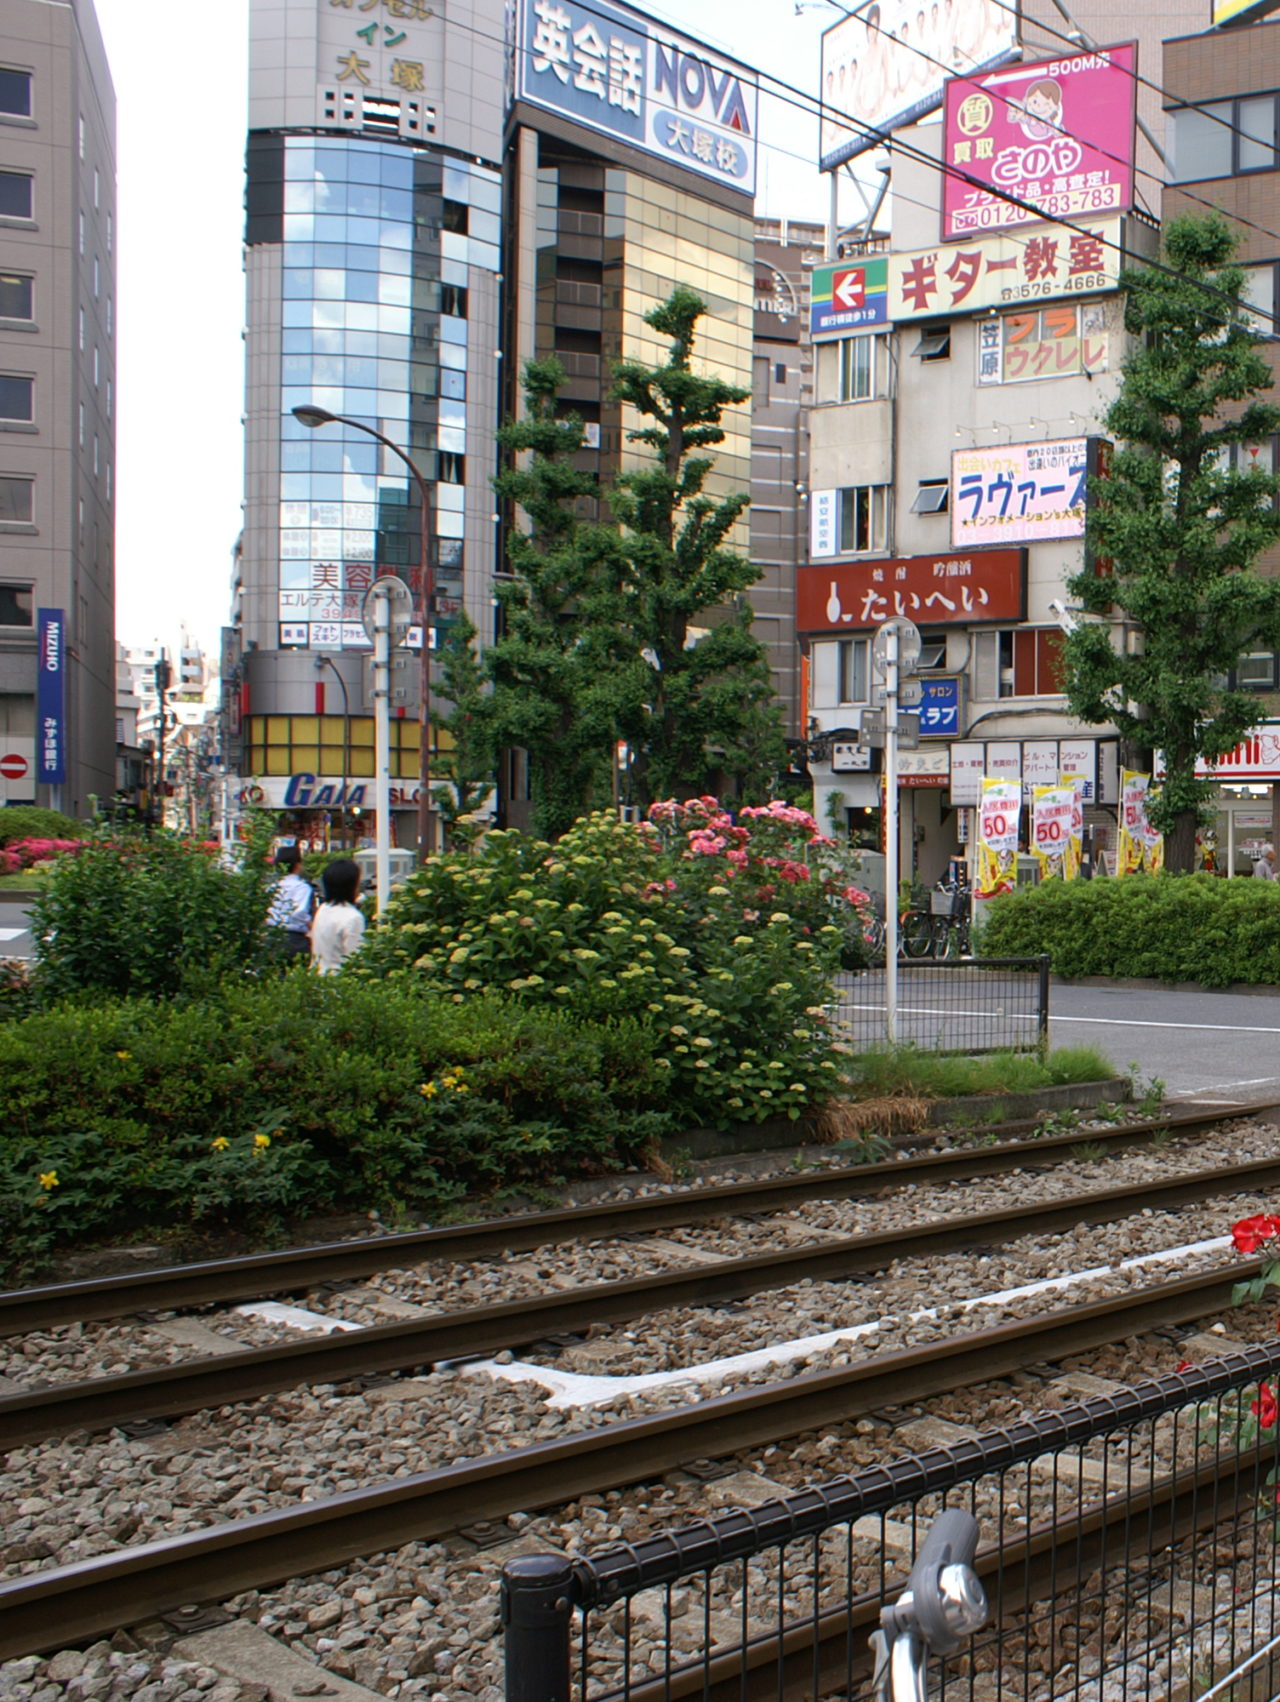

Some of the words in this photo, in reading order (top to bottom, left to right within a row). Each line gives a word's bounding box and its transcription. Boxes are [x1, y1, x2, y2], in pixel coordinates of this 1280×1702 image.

[356, 22, 407, 47] イン
[336, 50, 425, 92] 大塚
[532, 0, 643, 118] 英会話
[1049, 52, 1111, 77] 500M先
[654, 34, 751, 135] NOVA
[962, 98, 989, 132] 質
[666, 118, 741, 176] 大塚校
[954, 137, 994, 164] 買取
[991, 138, 1082, 185] さのや
[980, 186, 1115, 225] 0120-783-783
[901, 228, 1106, 312] ギター教室
[981, 324, 1000, 377] 笠原
[1005, 339, 1105, 376] ウクレレ
[958, 465, 1086, 518] ラヴァース
[861, 585, 988, 621] たいへい
[46, 621, 60, 671] MIZUHO
